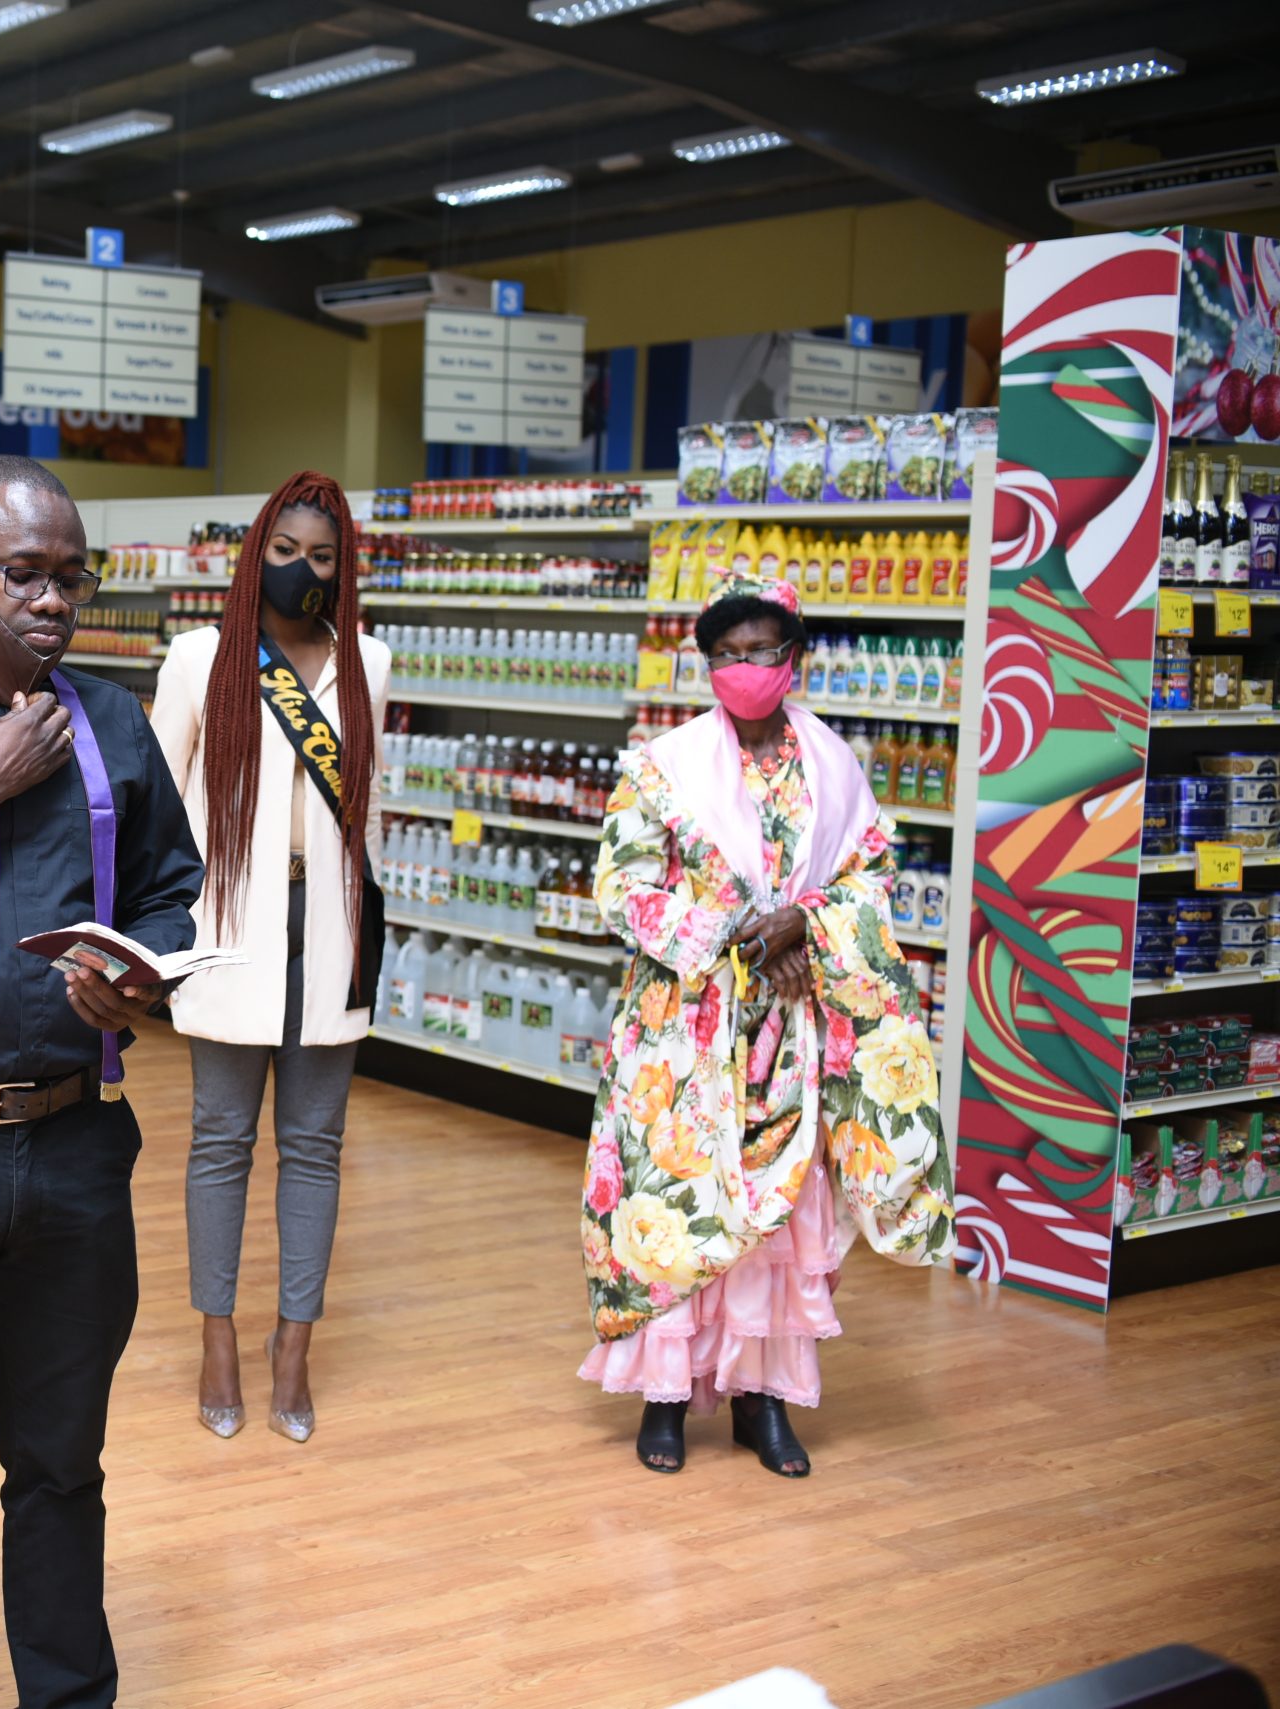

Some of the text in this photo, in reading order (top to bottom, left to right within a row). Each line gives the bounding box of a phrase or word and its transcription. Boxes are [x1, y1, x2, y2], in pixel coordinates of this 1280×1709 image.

[97, 236, 116, 262] 2
[502, 287, 519, 313] 3
[854, 322, 867, 342] 4
[1253, 521, 1280, 535] HERO
[260, 668, 308, 732] Miss
